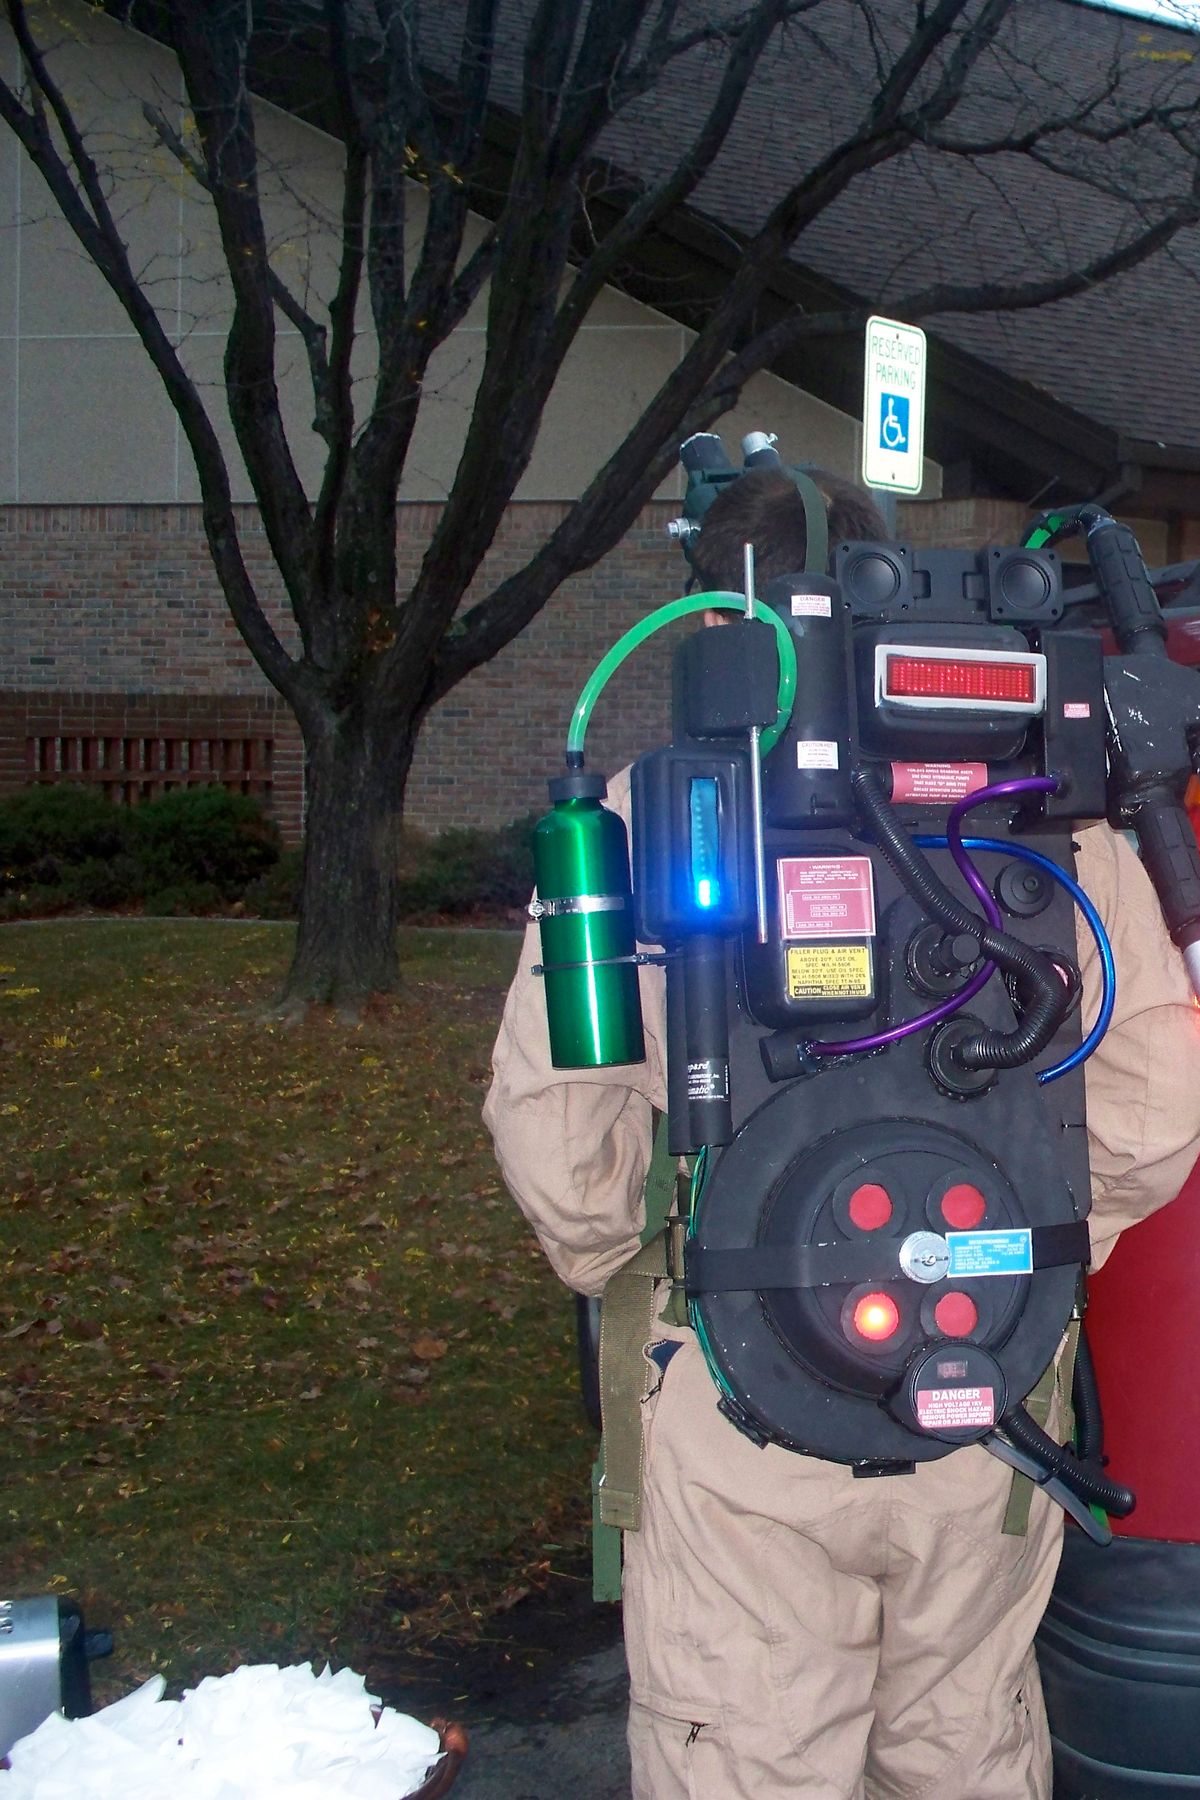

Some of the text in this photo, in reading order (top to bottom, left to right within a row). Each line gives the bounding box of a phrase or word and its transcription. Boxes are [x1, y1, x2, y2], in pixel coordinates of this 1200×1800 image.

[871, 335, 921, 366] RESERVED
[876, 362, 916, 390] PARKING
[794, 986, 822, 995] CAUTION
[932, 1389, 980, 1401] DANGER
